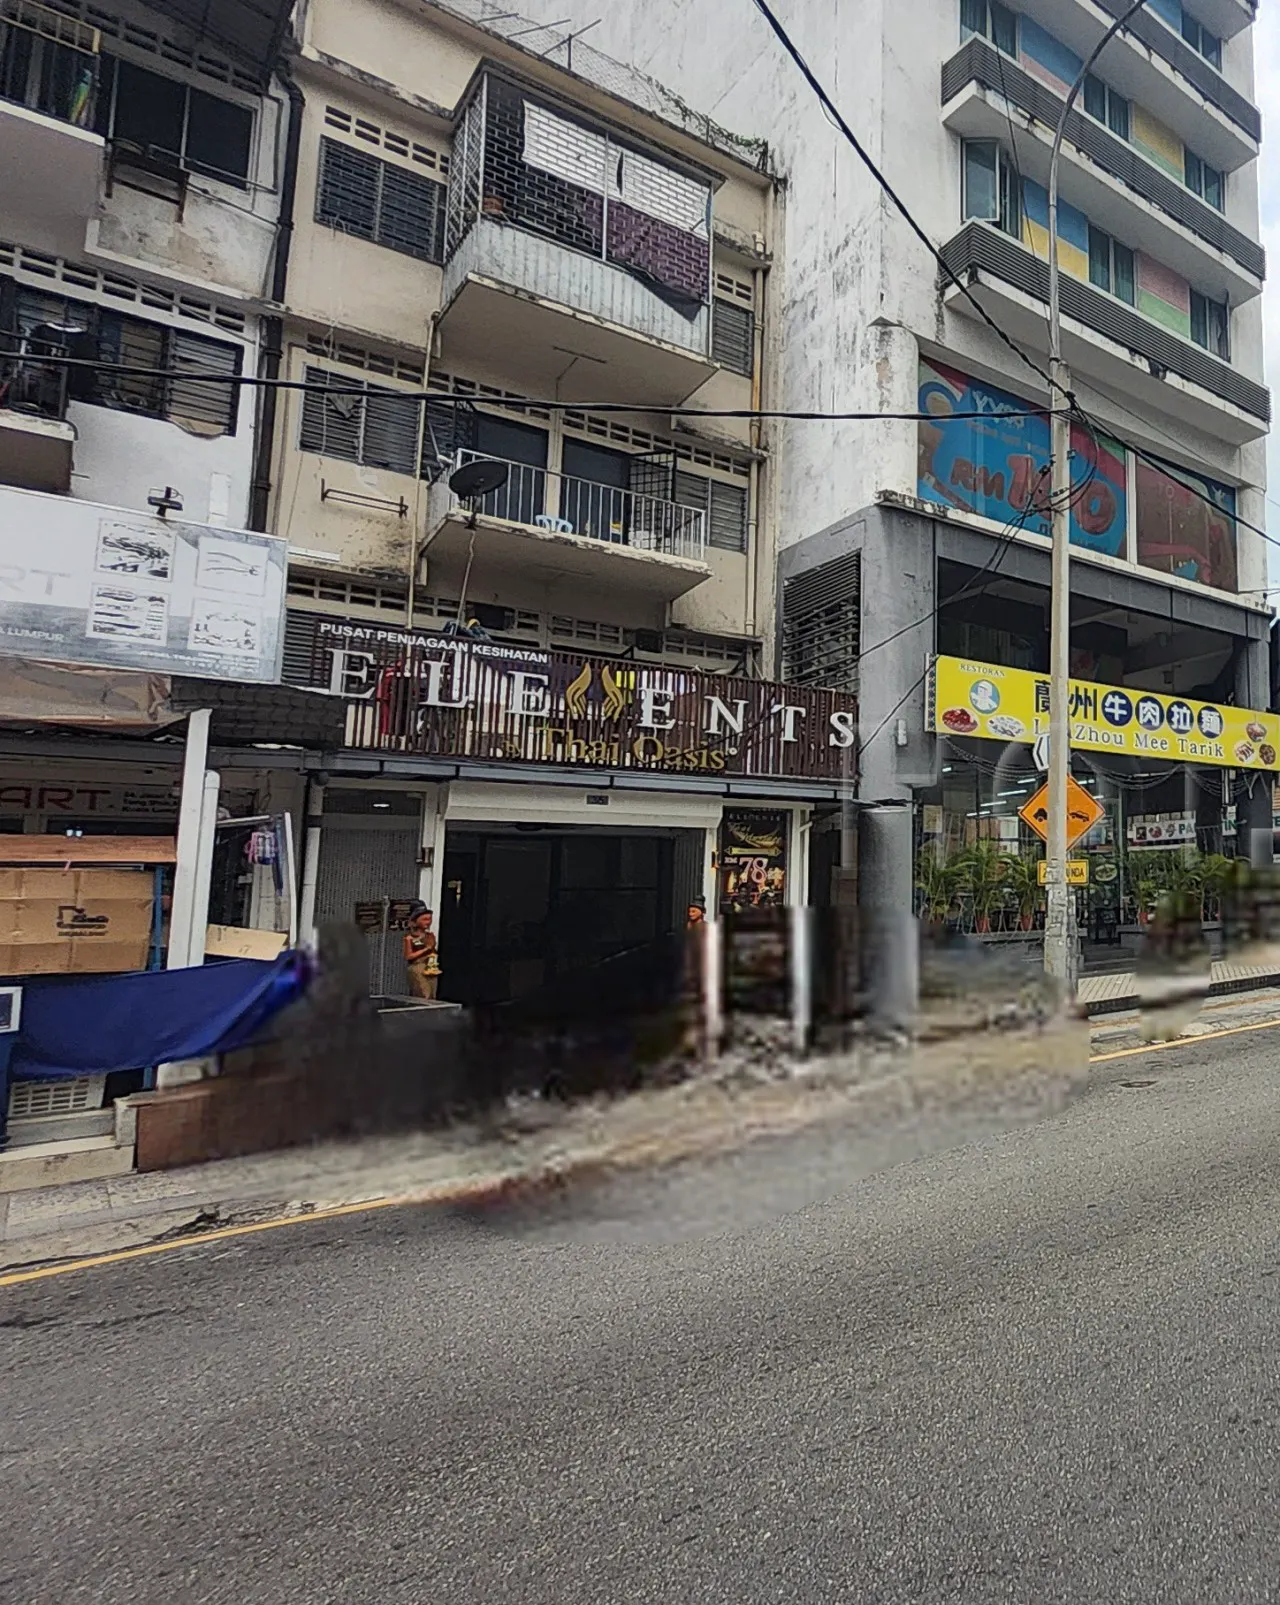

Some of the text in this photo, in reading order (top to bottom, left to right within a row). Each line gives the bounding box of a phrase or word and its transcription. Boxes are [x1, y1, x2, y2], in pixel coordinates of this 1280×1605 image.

[7, 626, 65, 643] LUMPUR
[320, 622, 548, 664] PUSAT PENJAGAAN KESIHATAN
[960, 663, 1005, 677] RESTORAN
[535, 726, 620, 761] Thai
[633, 735, 726, 770] Oasis
[1134, 732, 1168, 751] Mee
[1178, 738, 1224, 757] Tarik
[739, 857, 768, 884] 78
